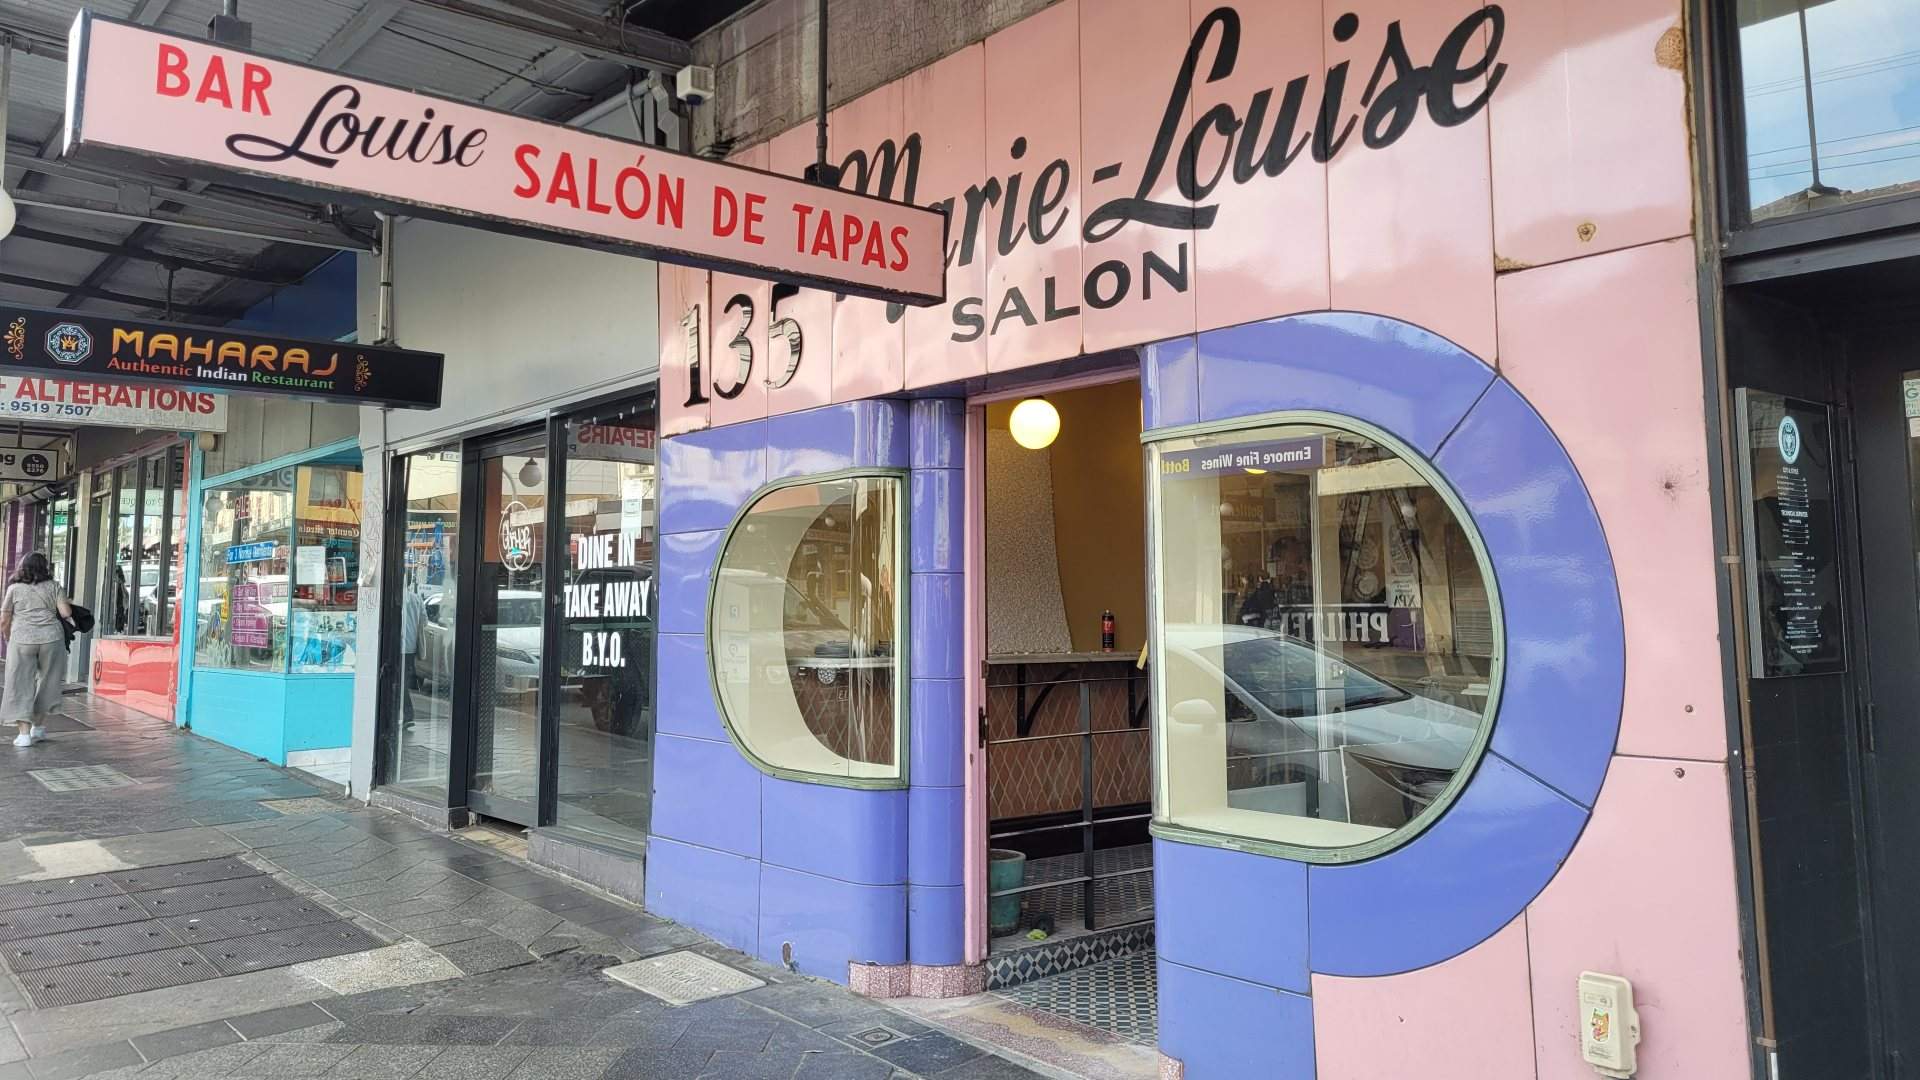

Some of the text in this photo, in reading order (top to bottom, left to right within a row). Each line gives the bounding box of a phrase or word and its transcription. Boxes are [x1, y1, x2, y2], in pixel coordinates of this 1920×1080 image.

[156, 43, 910, 272] BAR Louise SALÓN DE TAPAS
[951, 242, 1189, 343] SALON
[112, 327, 339, 376] MAHARAJ
[681, 283, 804, 408] 135
[107, 356, 335, 390] Authentic Indian Restaurant
[10, 400, 93, 416] 9519 7507
[15, 376, 216, 415] ALTERATIONS
[577, 532, 636, 570] DINE IN
[563, 581, 650, 619] TAKE AWAY
[582, 631, 626, 668] B.Y.O.
